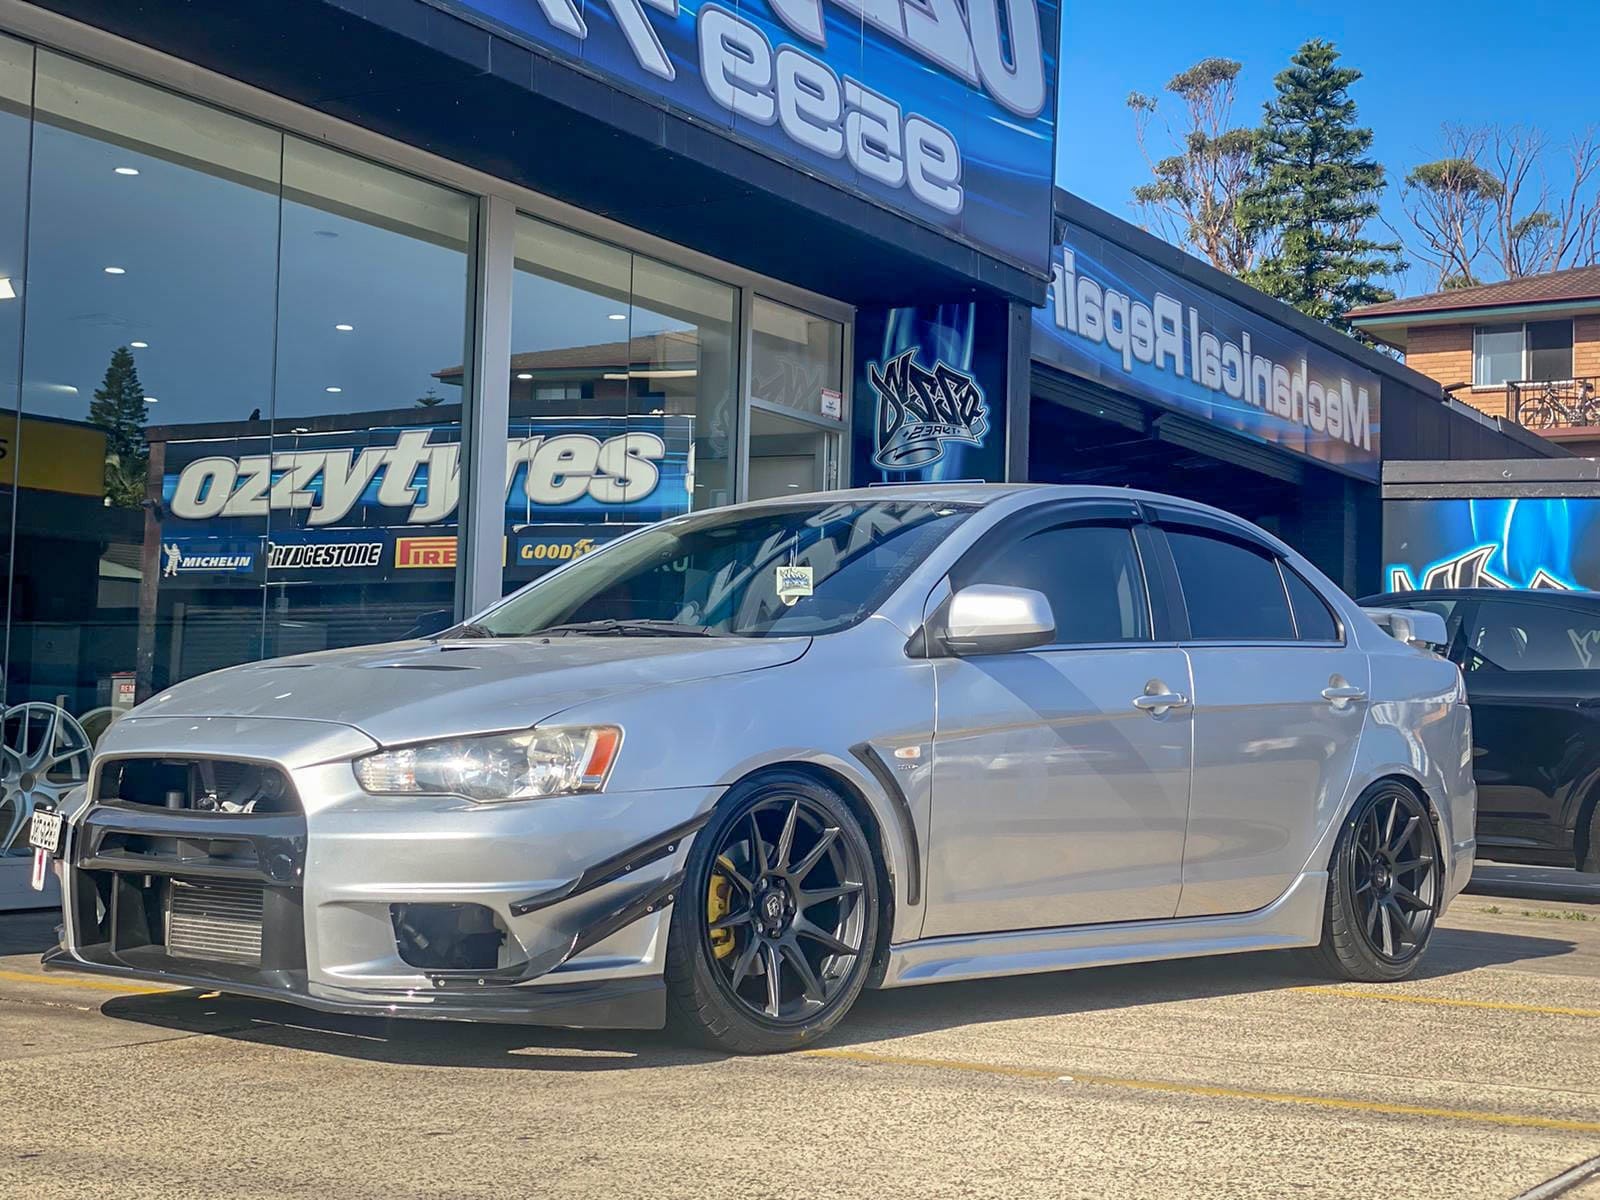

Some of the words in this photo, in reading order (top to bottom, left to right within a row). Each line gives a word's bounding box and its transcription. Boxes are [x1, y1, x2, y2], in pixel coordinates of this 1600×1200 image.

[400, 540, 457, 565] PIRE
[521, 544, 601, 559] GOOD
[181, 555, 251, 568] MICHELIN
